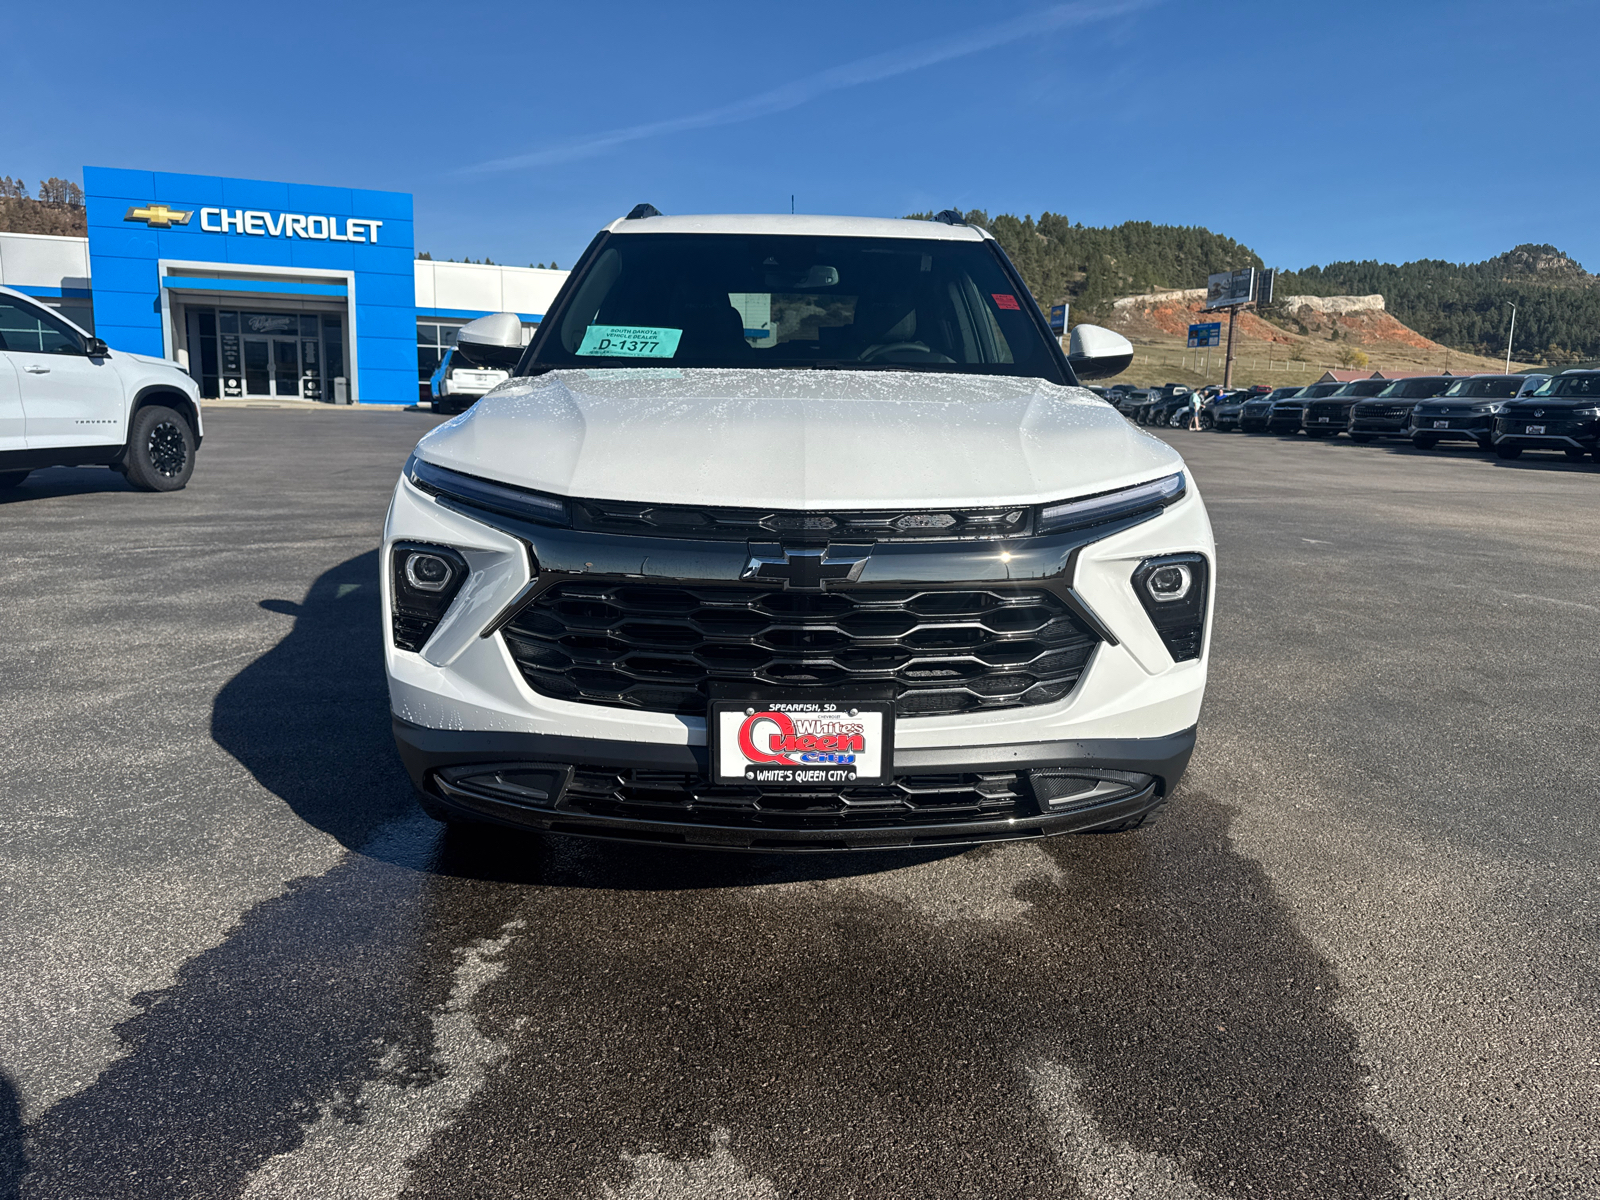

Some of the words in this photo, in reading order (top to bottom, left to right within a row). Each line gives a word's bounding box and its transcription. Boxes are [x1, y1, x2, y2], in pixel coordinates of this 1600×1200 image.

[200, 207, 383, 243] CHEVROLET
[598, 338, 660, 353] D-1377
[768, 703, 821, 712] SPEARFISH,
[823, 703, 837, 711] SD
[795, 719, 865, 735] White's
[738, 711, 865, 765] Queen
[800, 752, 856, 765] City
[756, 770, 793, 781] WHITE'S
[795, 770, 826, 783] QUEEN
[827, 770, 848, 781] CITY
